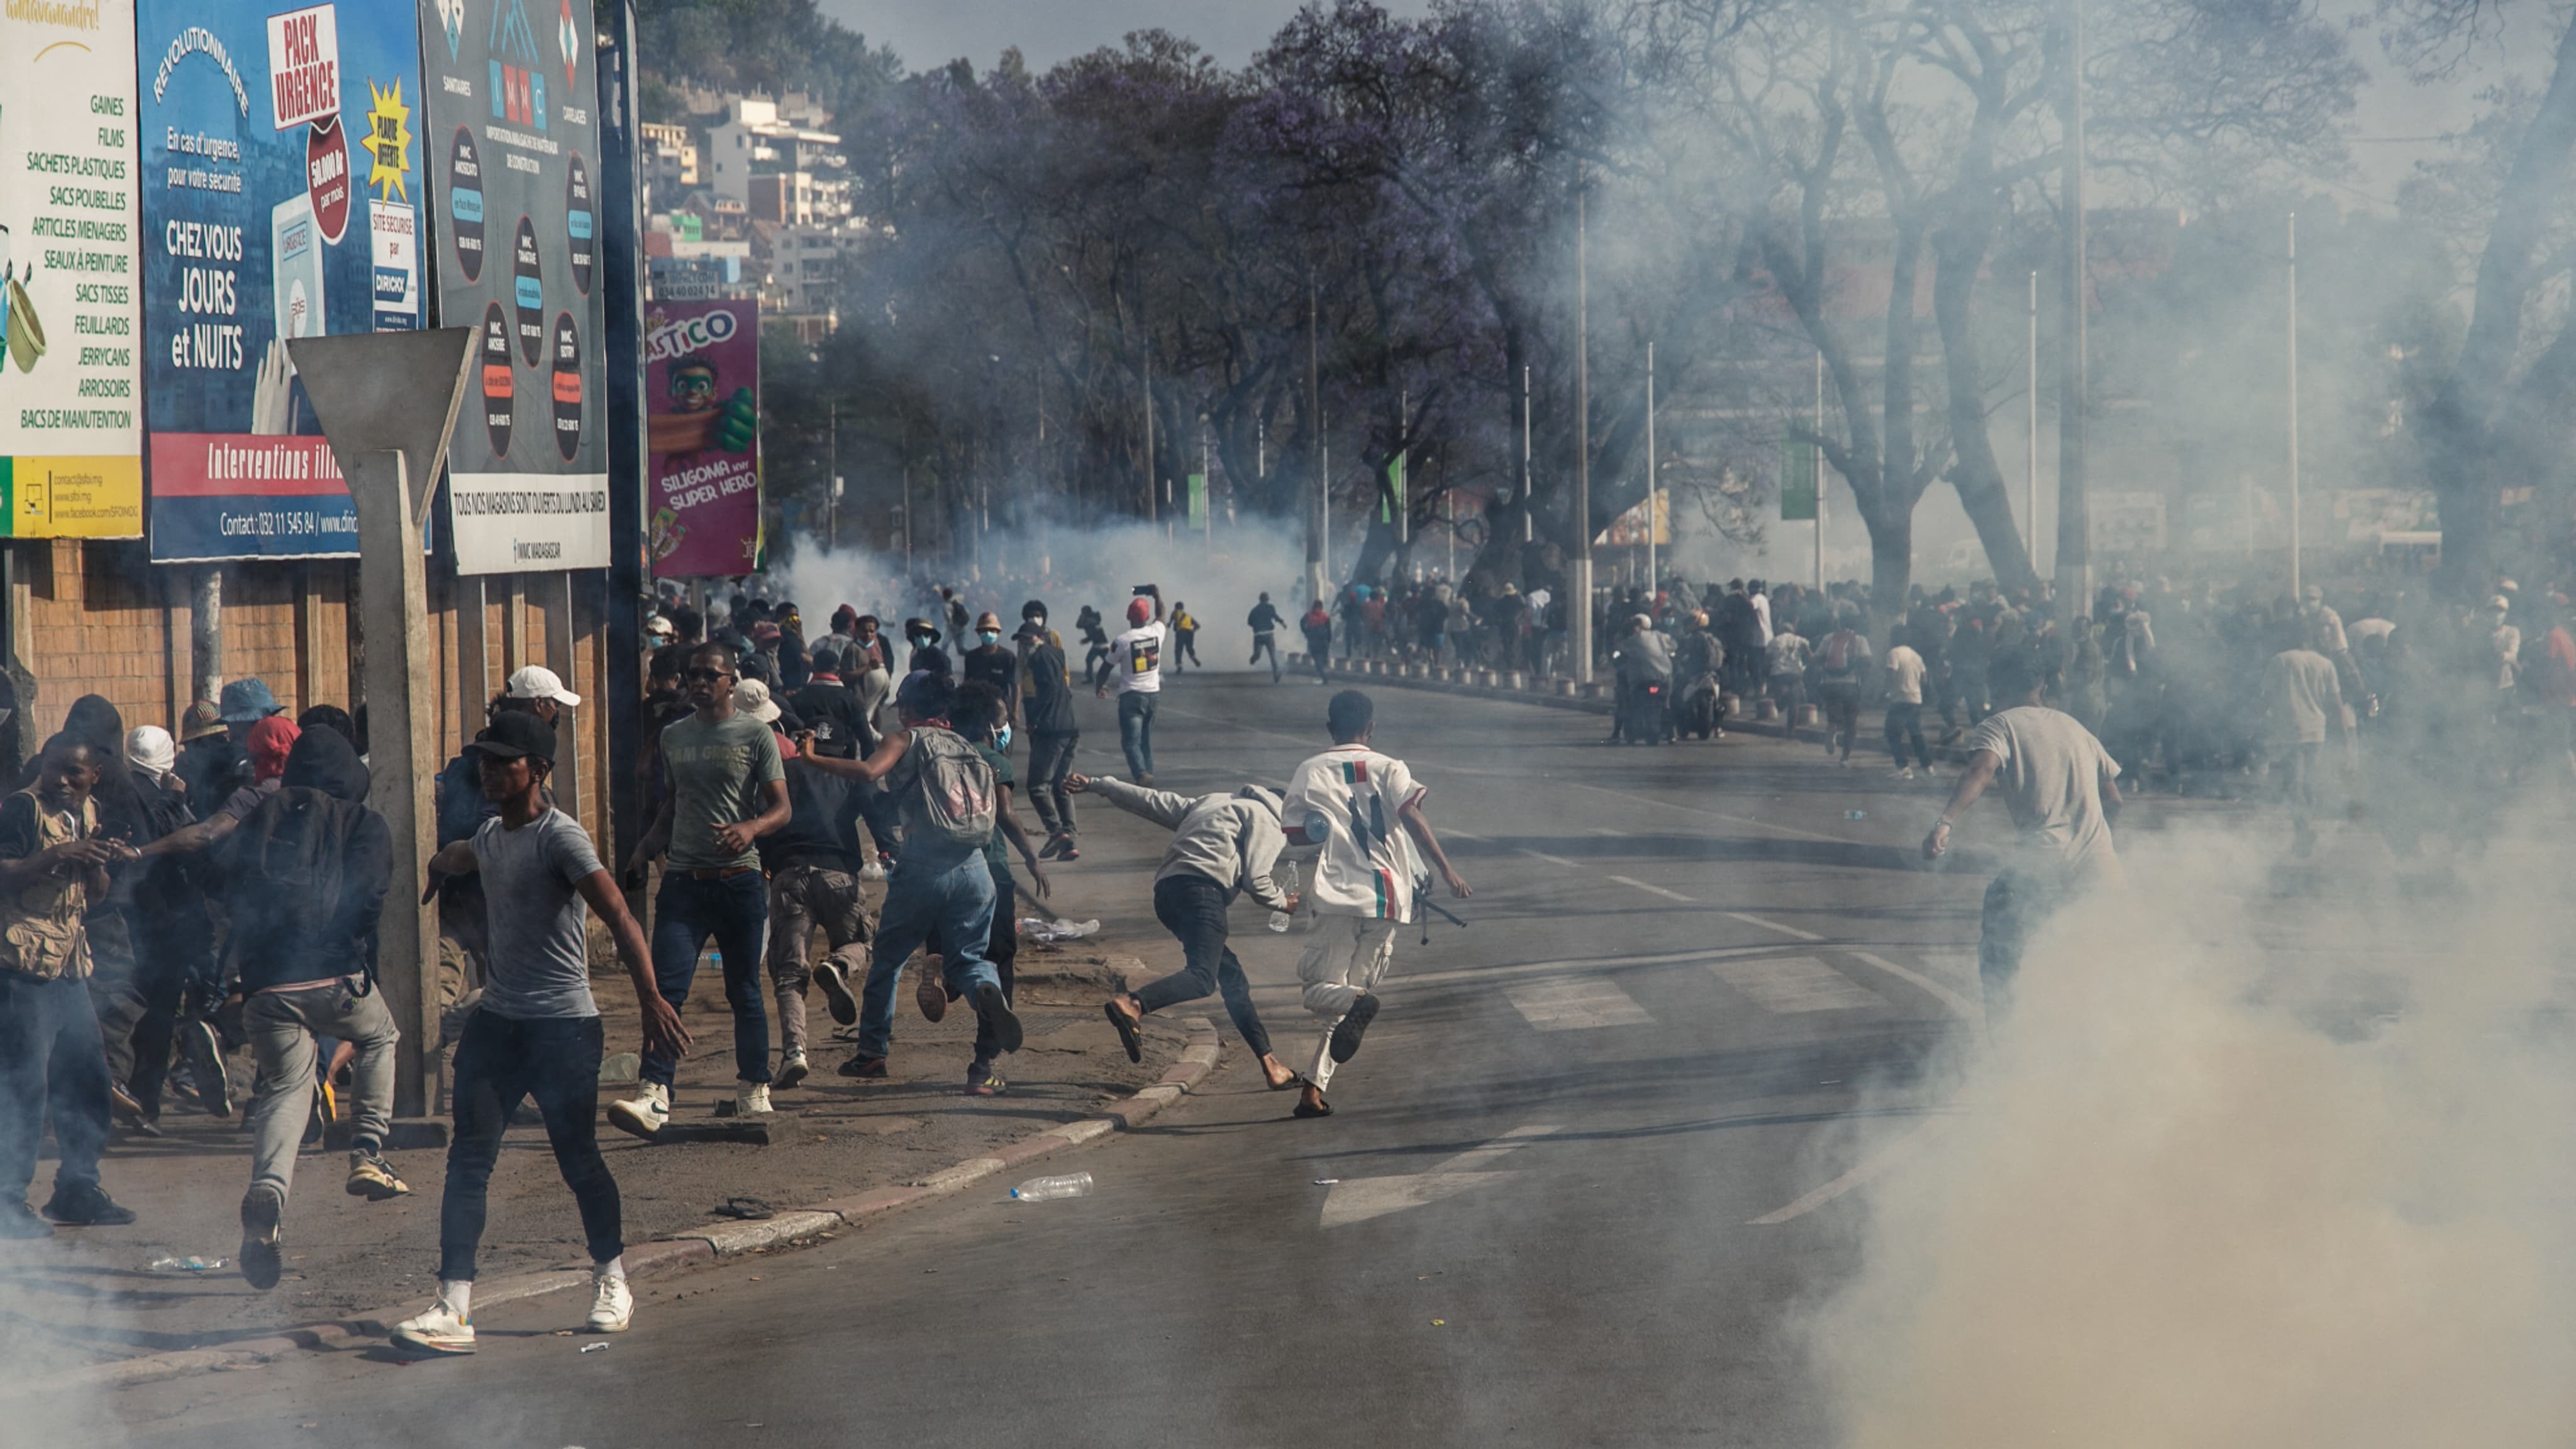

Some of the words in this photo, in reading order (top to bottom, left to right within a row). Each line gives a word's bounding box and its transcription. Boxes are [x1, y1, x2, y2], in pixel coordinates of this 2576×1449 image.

[283, 13, 319, 69] PACK
[153, 27, 249, 118] REVOLUTIONNAIRE
[275, 60, 335, 122] URGENCE
[91, 94, 124, 116] GAINES
[98, 128, 125, 148] FILMS
[377, 116, 397, 142] PLAQUE
[167, 126, 179, 152] En
[181, 134, 194, 154] cas
[196, 131, 240, 164] d'urgence,
[378, 142, 399, 169] OFFERTE
[27, 151, 69, 174] SACHETS
[71, 156, 125, 180] PLASTIQUES
[167, 167, 187, 191] pour
[188, 167, 207, 189] votre
[209, 167, 241, 194] sécurité
[50, 186, 74, 206] SACS
[75, 188, 126, 211] POUBELLES
[321, 192, 330, 213] par
[331, 183, 344, 204] mois
[32, 216, 75, 238] ARTICLES
[77, 221, 126, 242] MENAGERS
[373, 214, 386, 231] SITE
[387, 215, 412, 235] SECURISE
[166, 219, 203, 258] CHEZ
[203, 223, 242, 262] VOUS
[389, 243, 399, 259] par
[45, 250, 75, 270] SEAUX
[76, 248, 84, 270] À
[86, 252, 128, 273] PEINTURE
[75, 284, 98, 303] SACS
[101, 285, 128, 304] TISSES
[178, 267, 236, 316] JOURS
[659, 286, 674, 297] 034
[676, 286, 686, 296] 40
[688, 286, 703, 296] 024
[706, 284, 715, 295] 14
[74, 315, 130, 335] FEUILLARDS
[78, 347, 130, 367] JERRYCANS
[172, 327, 191, 368] et
[194, 323, 243, 370] NUITS
[78, 379, 130, 397] ARROSOIRS
[21, 409, 46, 428] BACS
[47, 409, 61, 428] DE
[62, 410, 131, 428] MANUTENTION
[208, 442, 308, 480] Interventions
[661, 460, 730, 493] SILIGOMA
[454, 492, 471, 516] TOUS
[472, 492, 486, 515] NOS
[486, 492, 515, 515] MAGASINS
[516, 491, 531, 514] SONT
[533, 491, 555, 514] OUVERTS
[669, 484, 718, 511] SUPER
[719, 472, 757, 496] HERO
[220, 512, 255, 536] Contact
[259, 511, 274, 535] 032
[275, 512, 285, 534] 11
[287, 511, 303, 535] 545
[304, 511, 314, 534] 84
